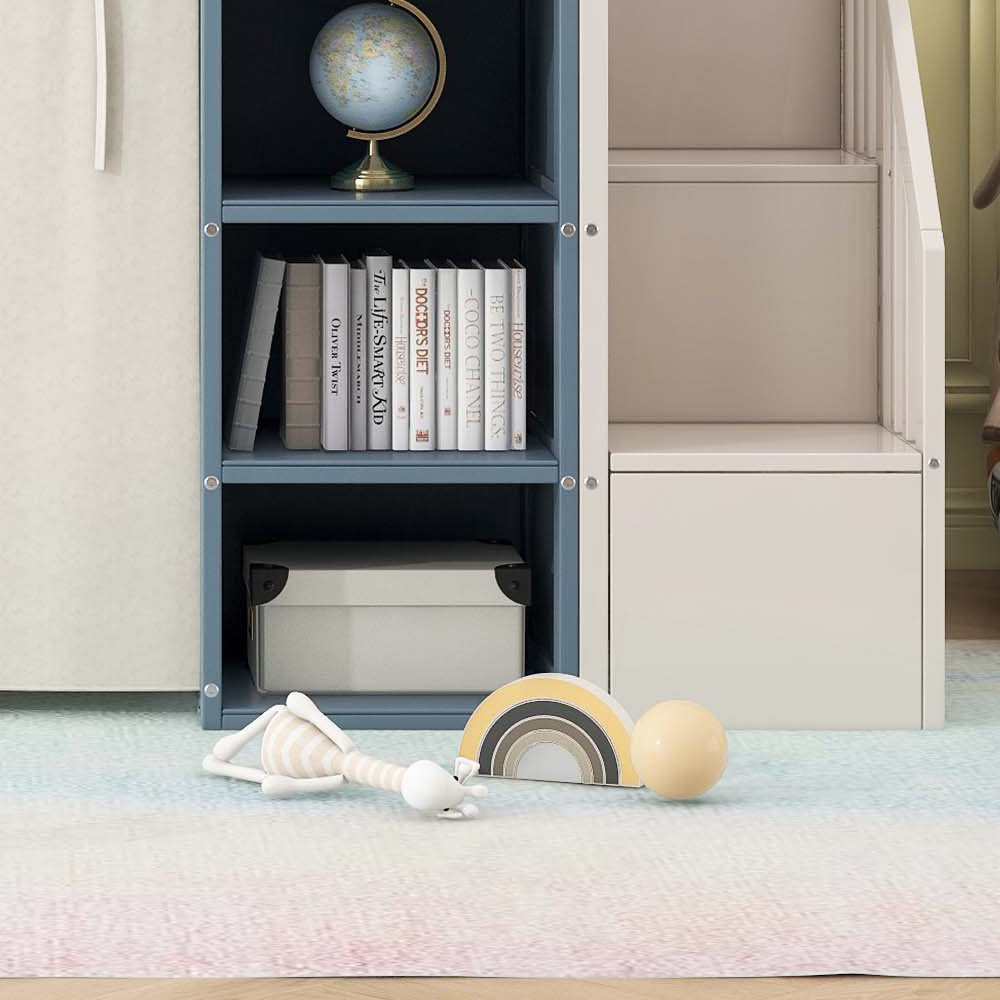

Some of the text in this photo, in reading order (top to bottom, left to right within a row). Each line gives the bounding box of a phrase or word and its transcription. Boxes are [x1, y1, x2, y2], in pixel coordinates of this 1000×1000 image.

[489, 295, 504, 313] BE
[331, 317, 342, 397] OLIVER TWIST
[489, 320, 504, 362] TWO
[416, 348, 429, 376] DIET
[444, 351, 452, 369] DIET
[465, 355, 481, 429] CHANEL
